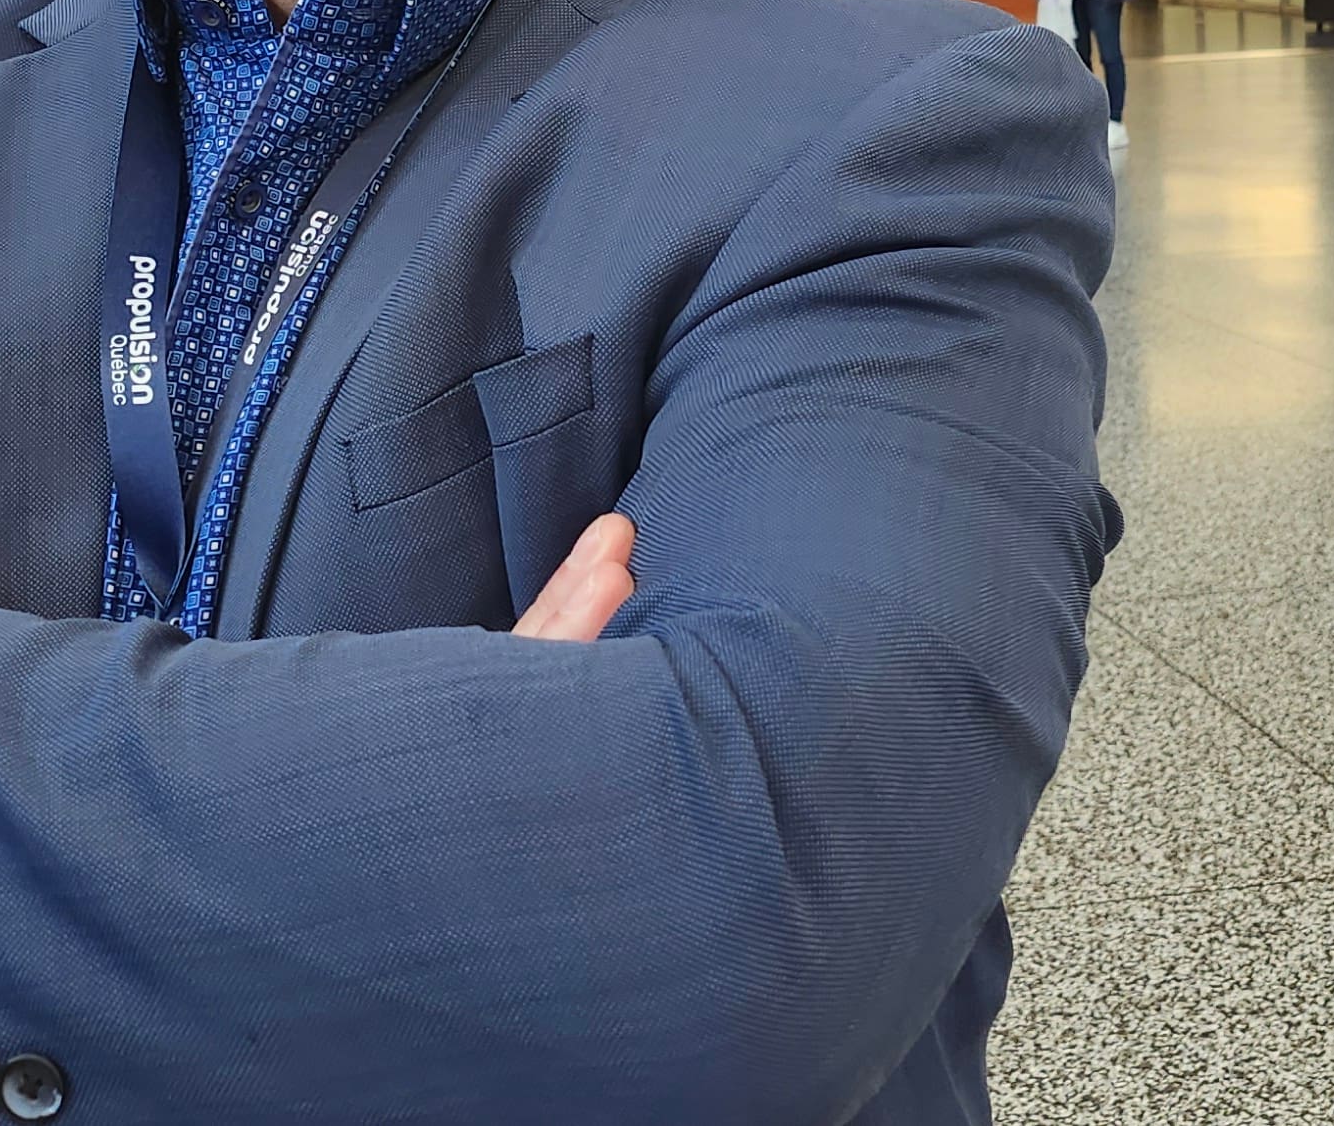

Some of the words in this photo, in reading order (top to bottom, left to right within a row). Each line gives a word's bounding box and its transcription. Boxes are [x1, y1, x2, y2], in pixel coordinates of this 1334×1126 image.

[243, 210, 329, 366] propulsion
[295, 215, 338, 277] Québec
[109, 334, 128, 406] Québec
[125, 255, 158, 405] propulsion
